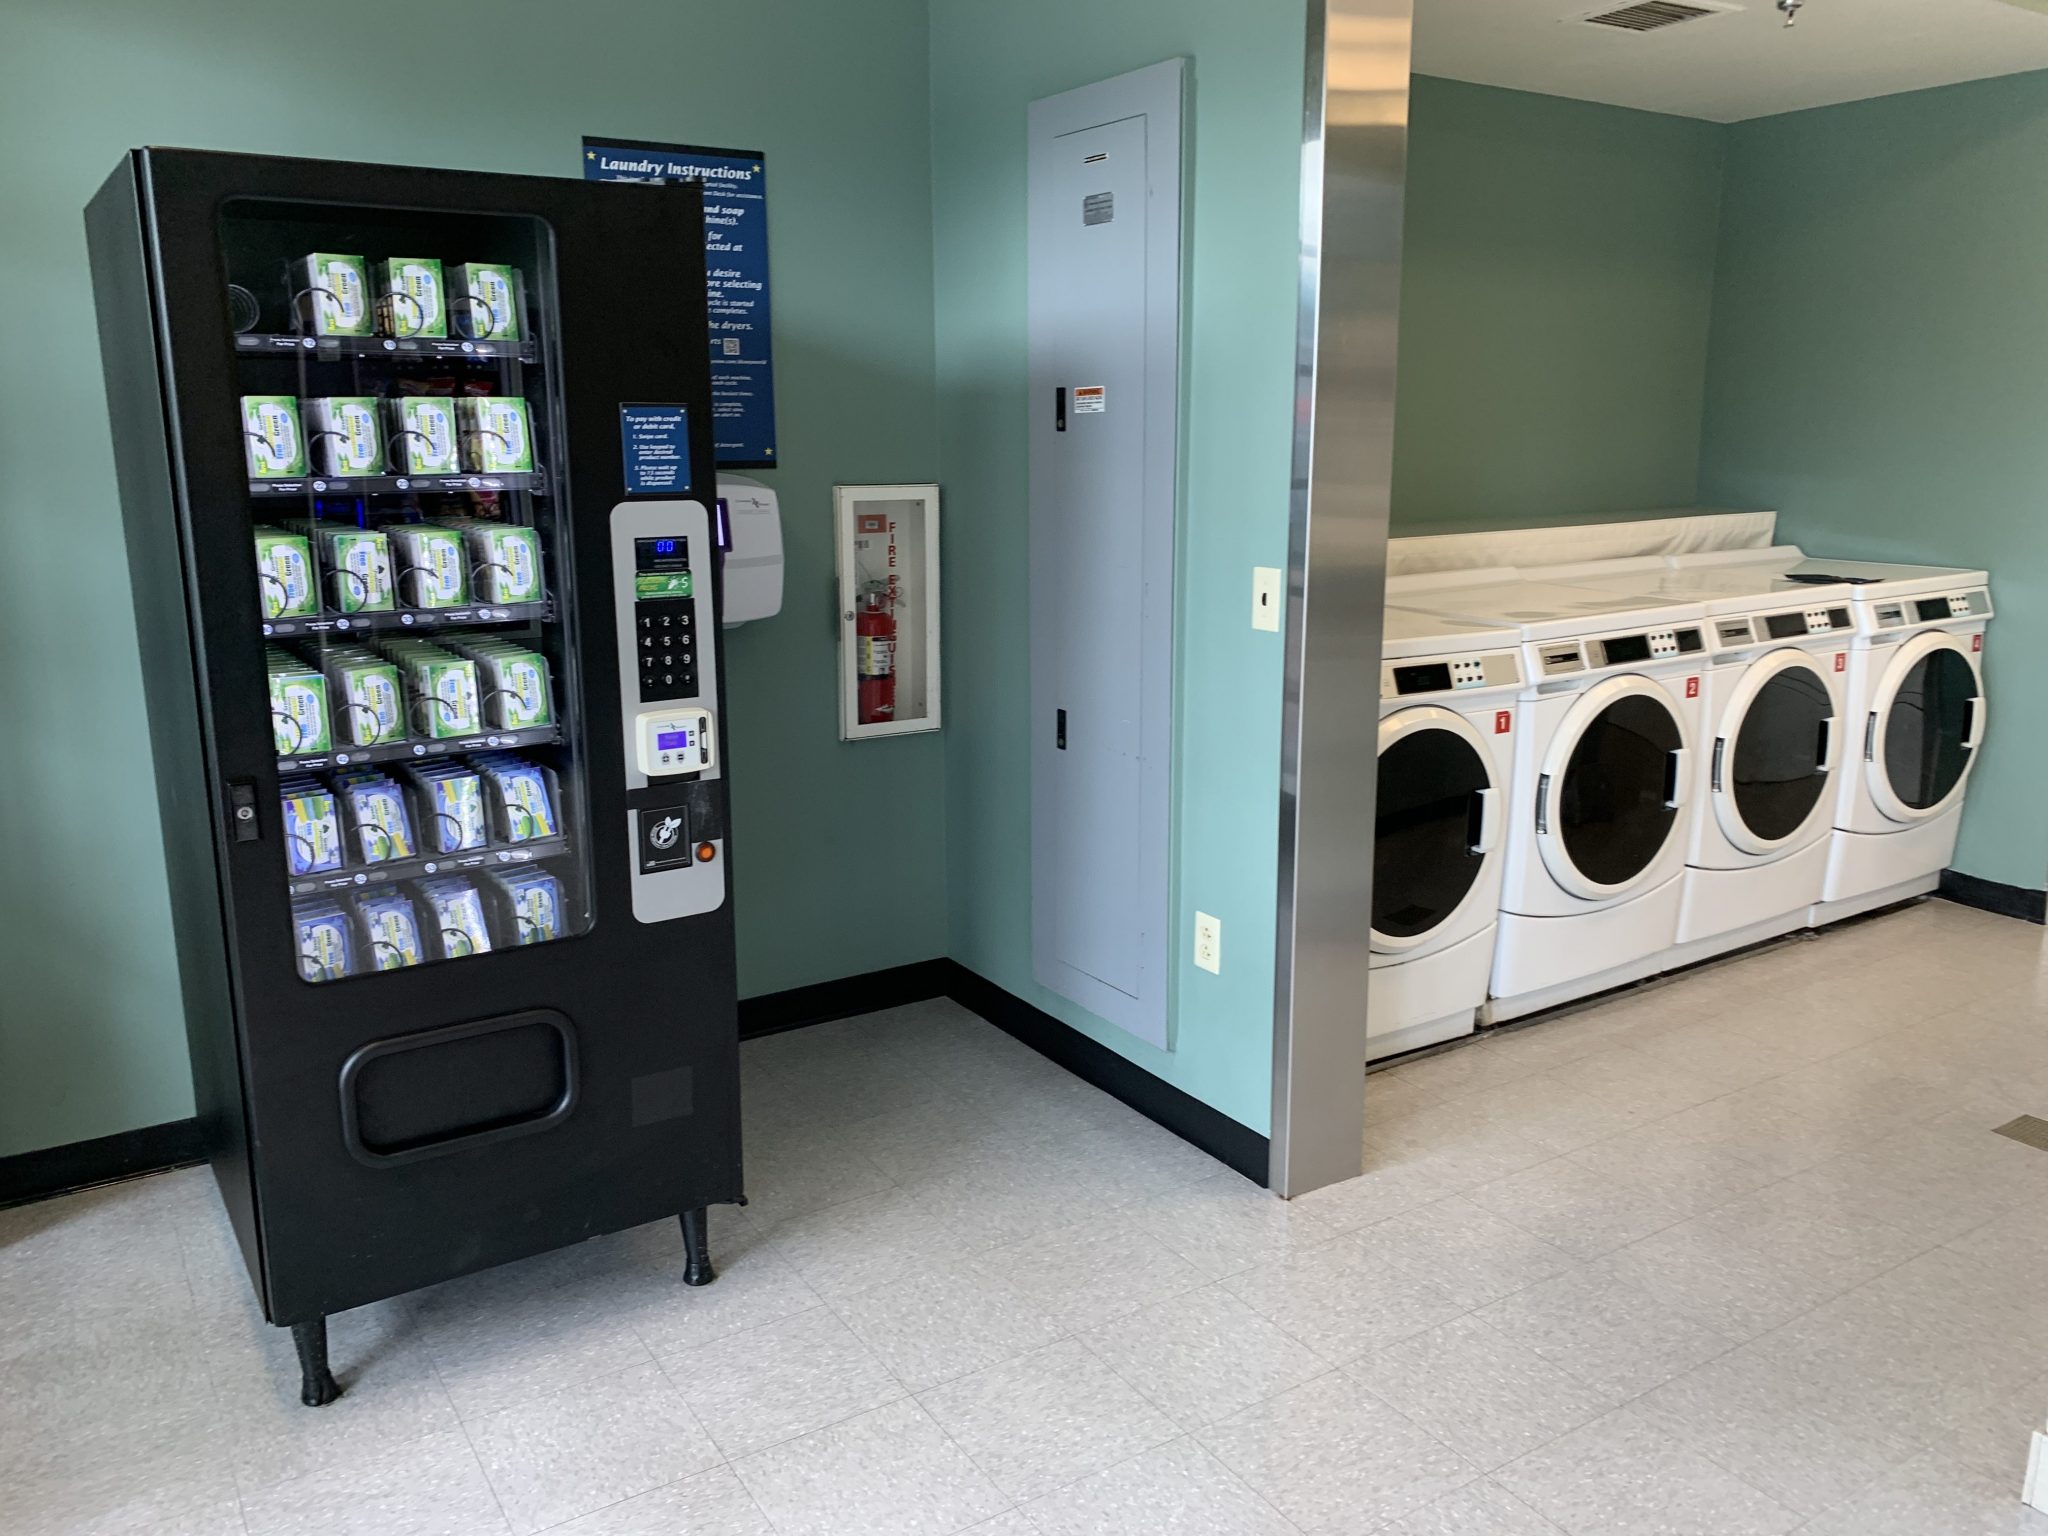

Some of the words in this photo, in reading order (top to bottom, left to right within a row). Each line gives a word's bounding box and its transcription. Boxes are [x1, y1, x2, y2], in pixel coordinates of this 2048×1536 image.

[601, 157, 664, 176] Laundry
[667, 162, 752, 181] Instructions
[721, 207, 744, 216] soap
[708, 230, 723, 241] for
[712, 268, 742, 278] desire
[722, 280, 762, 290] selecting
[721, 321, 754, 331] dryers.
[888, 522, 896, 567] FIRE
[644, 618, 650, 627] 1
[662, 616, 670, 626] 2
[681, 615, 689, 625] 3
[644, 637, 652, 647] 4
[663, 636, 671, 646] 5
[682, 635, 690, 644] 6
[646, 657, 653, 667] 7
[664, 656, 672, 665] 8
[683, 654, 691, 664] 9
[665, 675, 672, 685] 0
[1689, 682, 1696, 695] 2
[1499, 716, 1506, 730] 1
